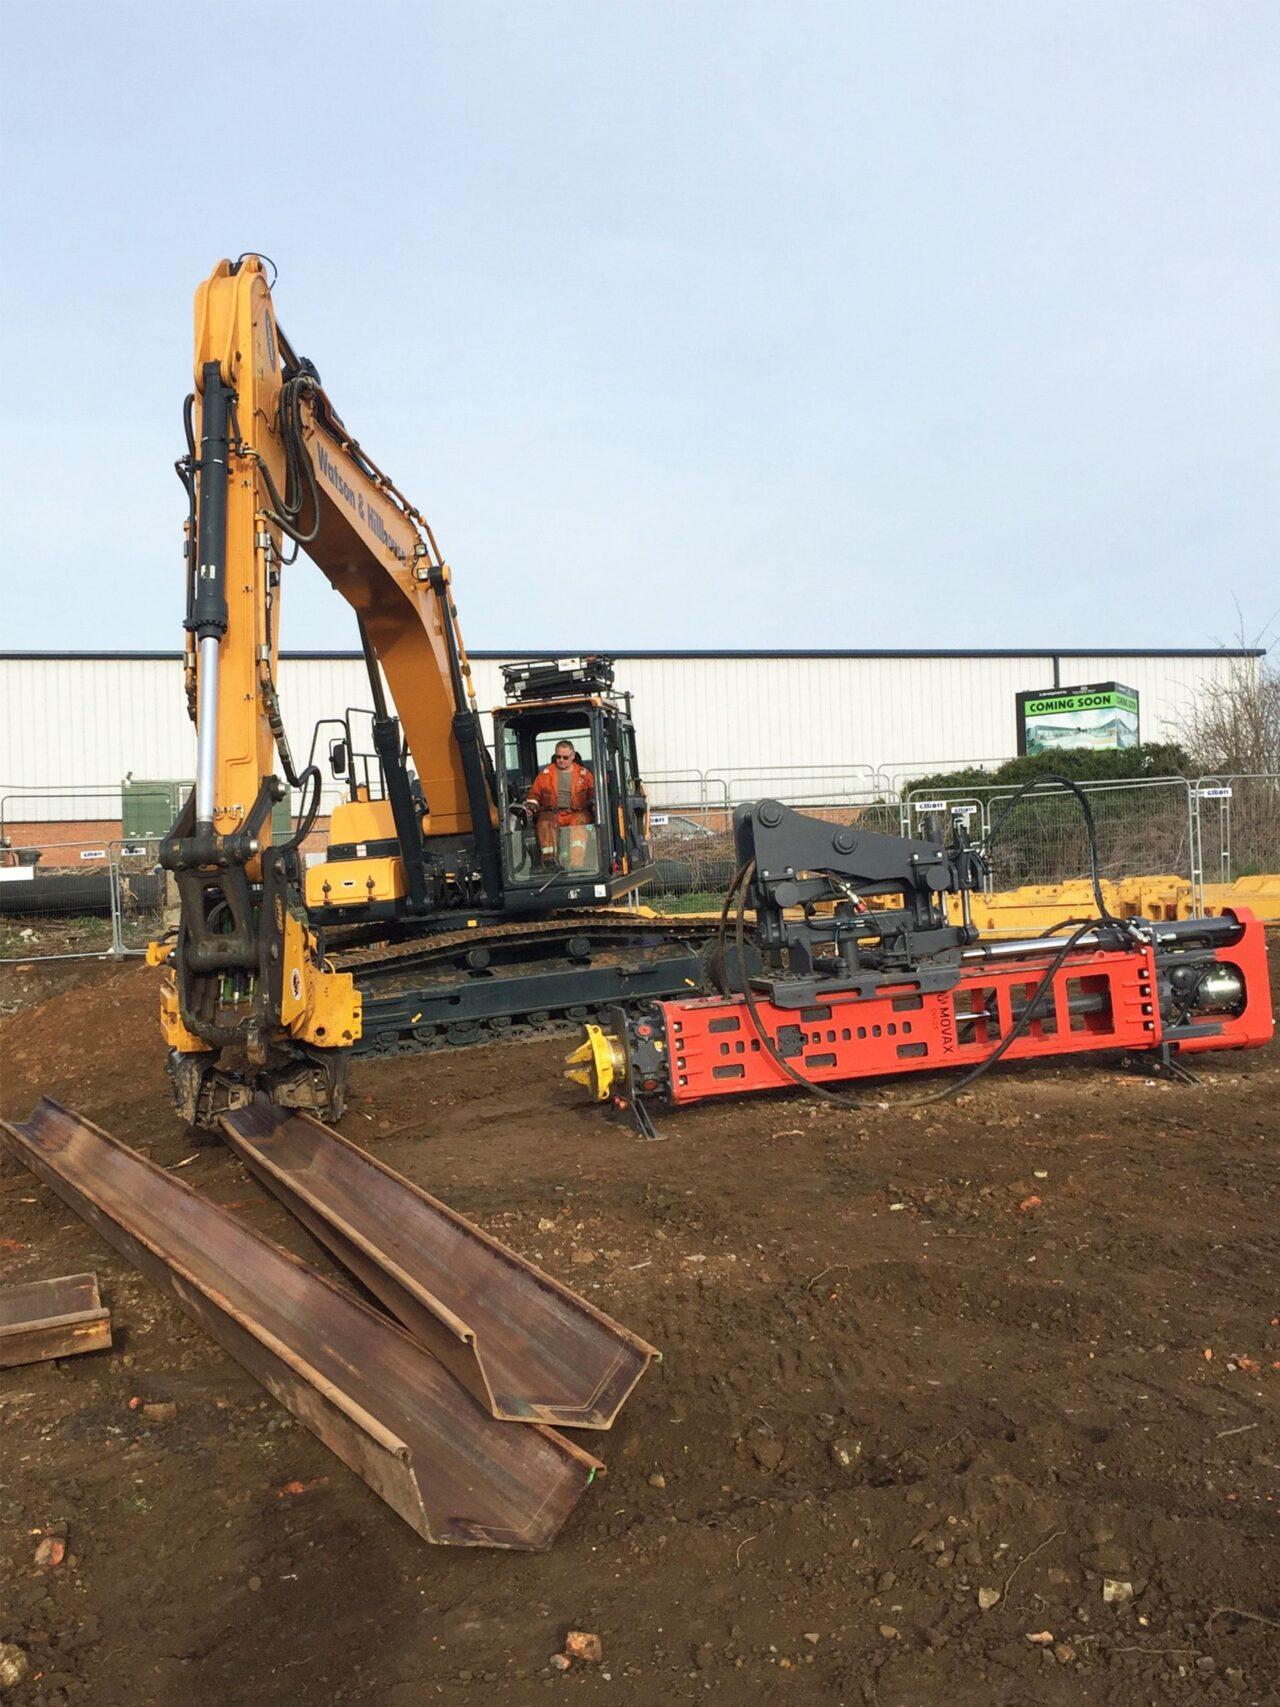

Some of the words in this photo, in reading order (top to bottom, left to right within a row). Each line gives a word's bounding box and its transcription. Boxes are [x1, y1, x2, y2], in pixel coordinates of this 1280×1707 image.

[317, 441, 355, 509] Watson
[358, 492, 365, 521] &
[1029, 700, 1074, 713] COMING
[1078, 695, 1111, 708] SOON
[939, 1007, 954, 1054] MOVAX
